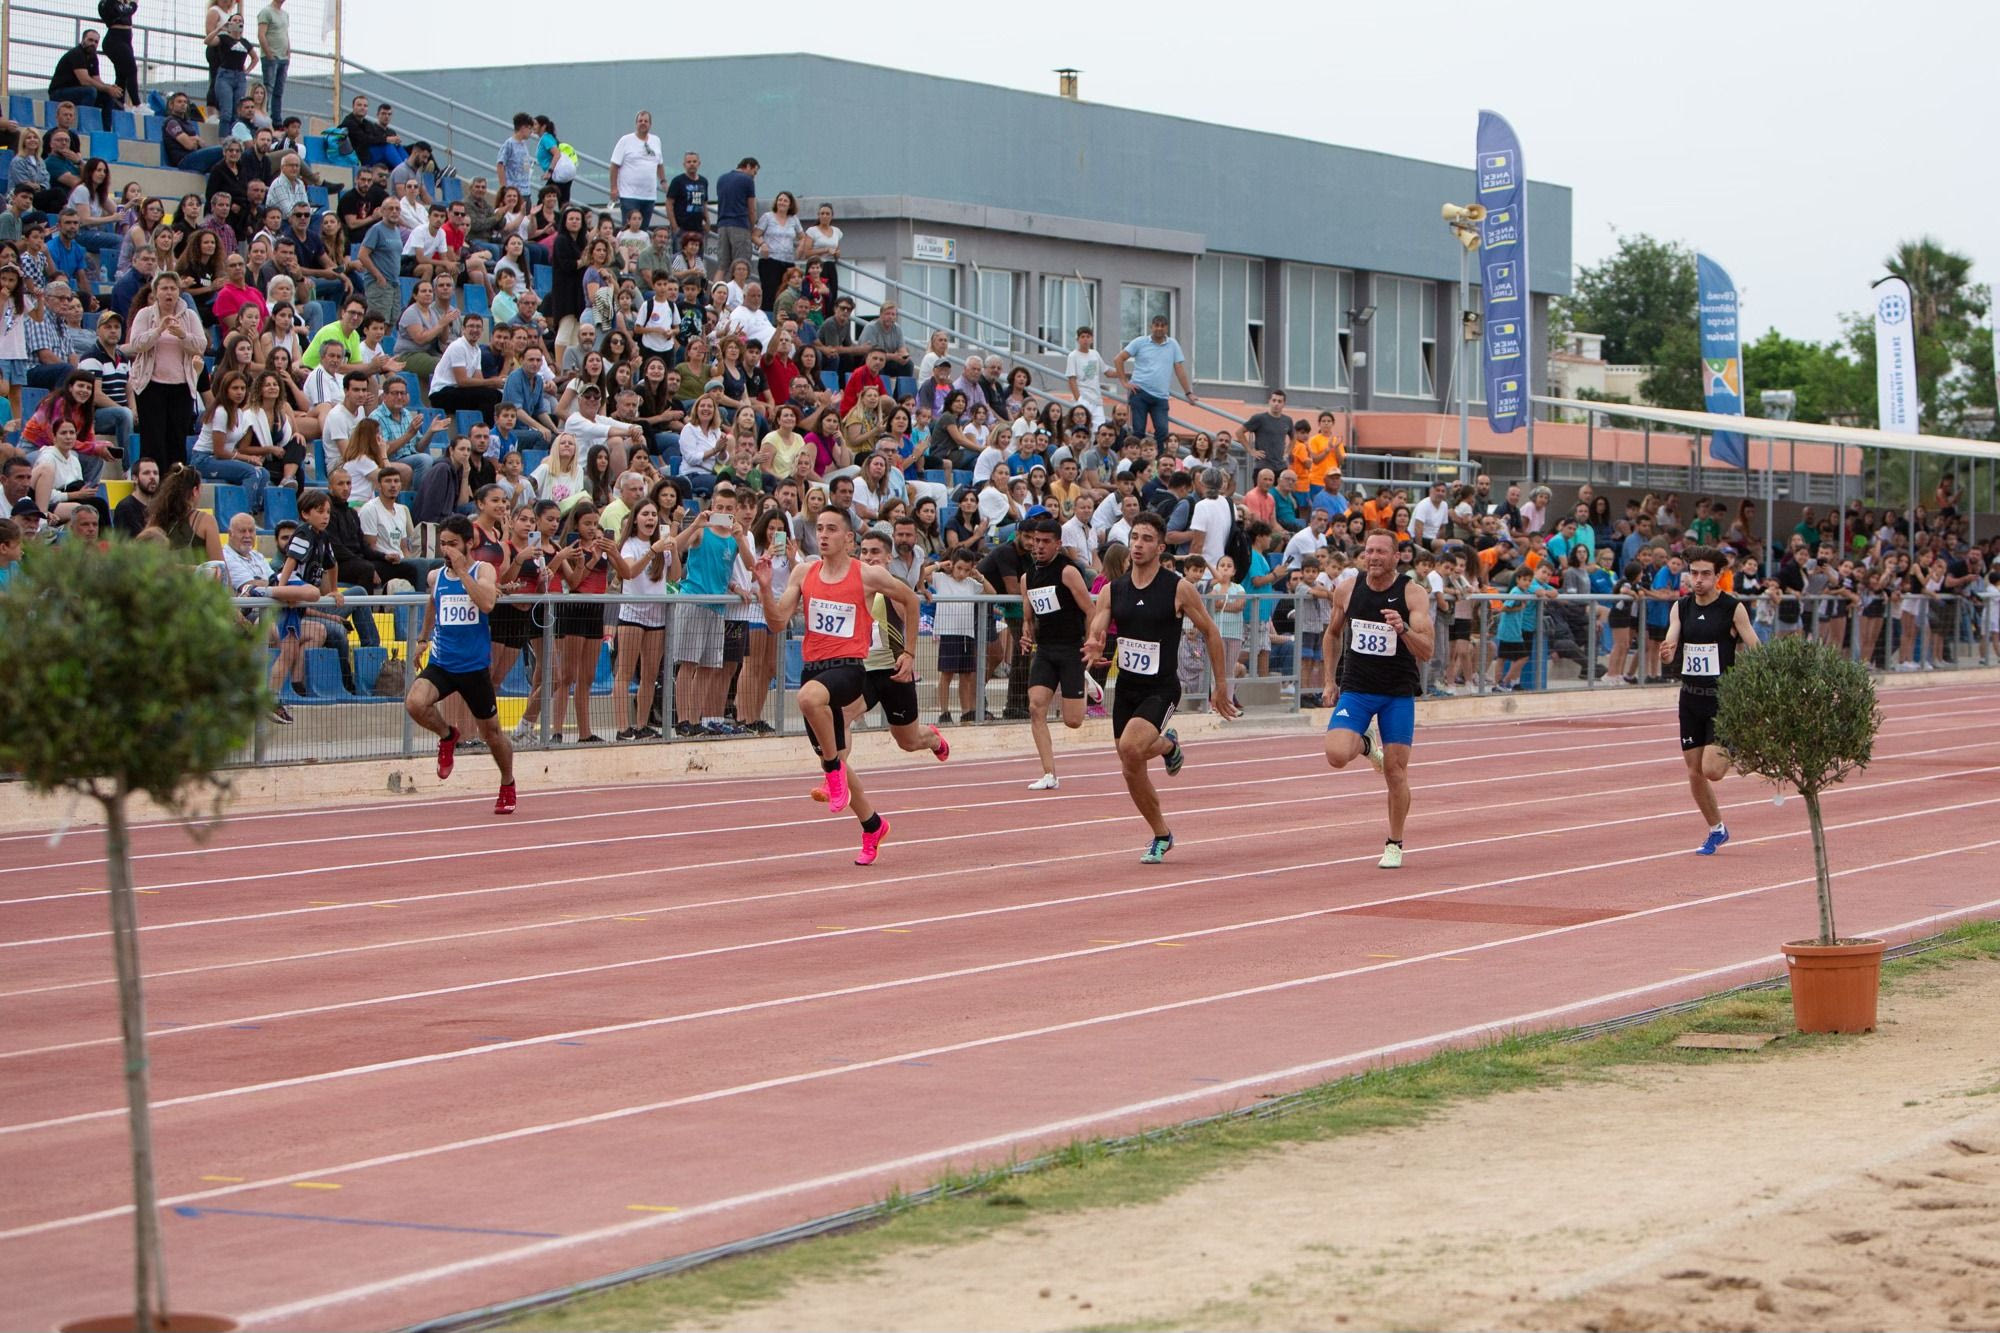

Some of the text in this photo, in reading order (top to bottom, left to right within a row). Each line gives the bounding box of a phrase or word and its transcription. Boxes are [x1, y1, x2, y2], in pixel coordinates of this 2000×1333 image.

[820, 602, 842, 611] ΣΕΓΑΣ
[1033, 597, 1052, 612] 391
[442, 606, 476, 622] 1906
[815, 612, 846, 633] 387
[1126, 641, 1147, 649] ΣΕΓΑΣ
[1358, 633, 1387, 652] 383
[1124, 651, 1151, 671] 379
[1686, 656, 1709, 673] 381
